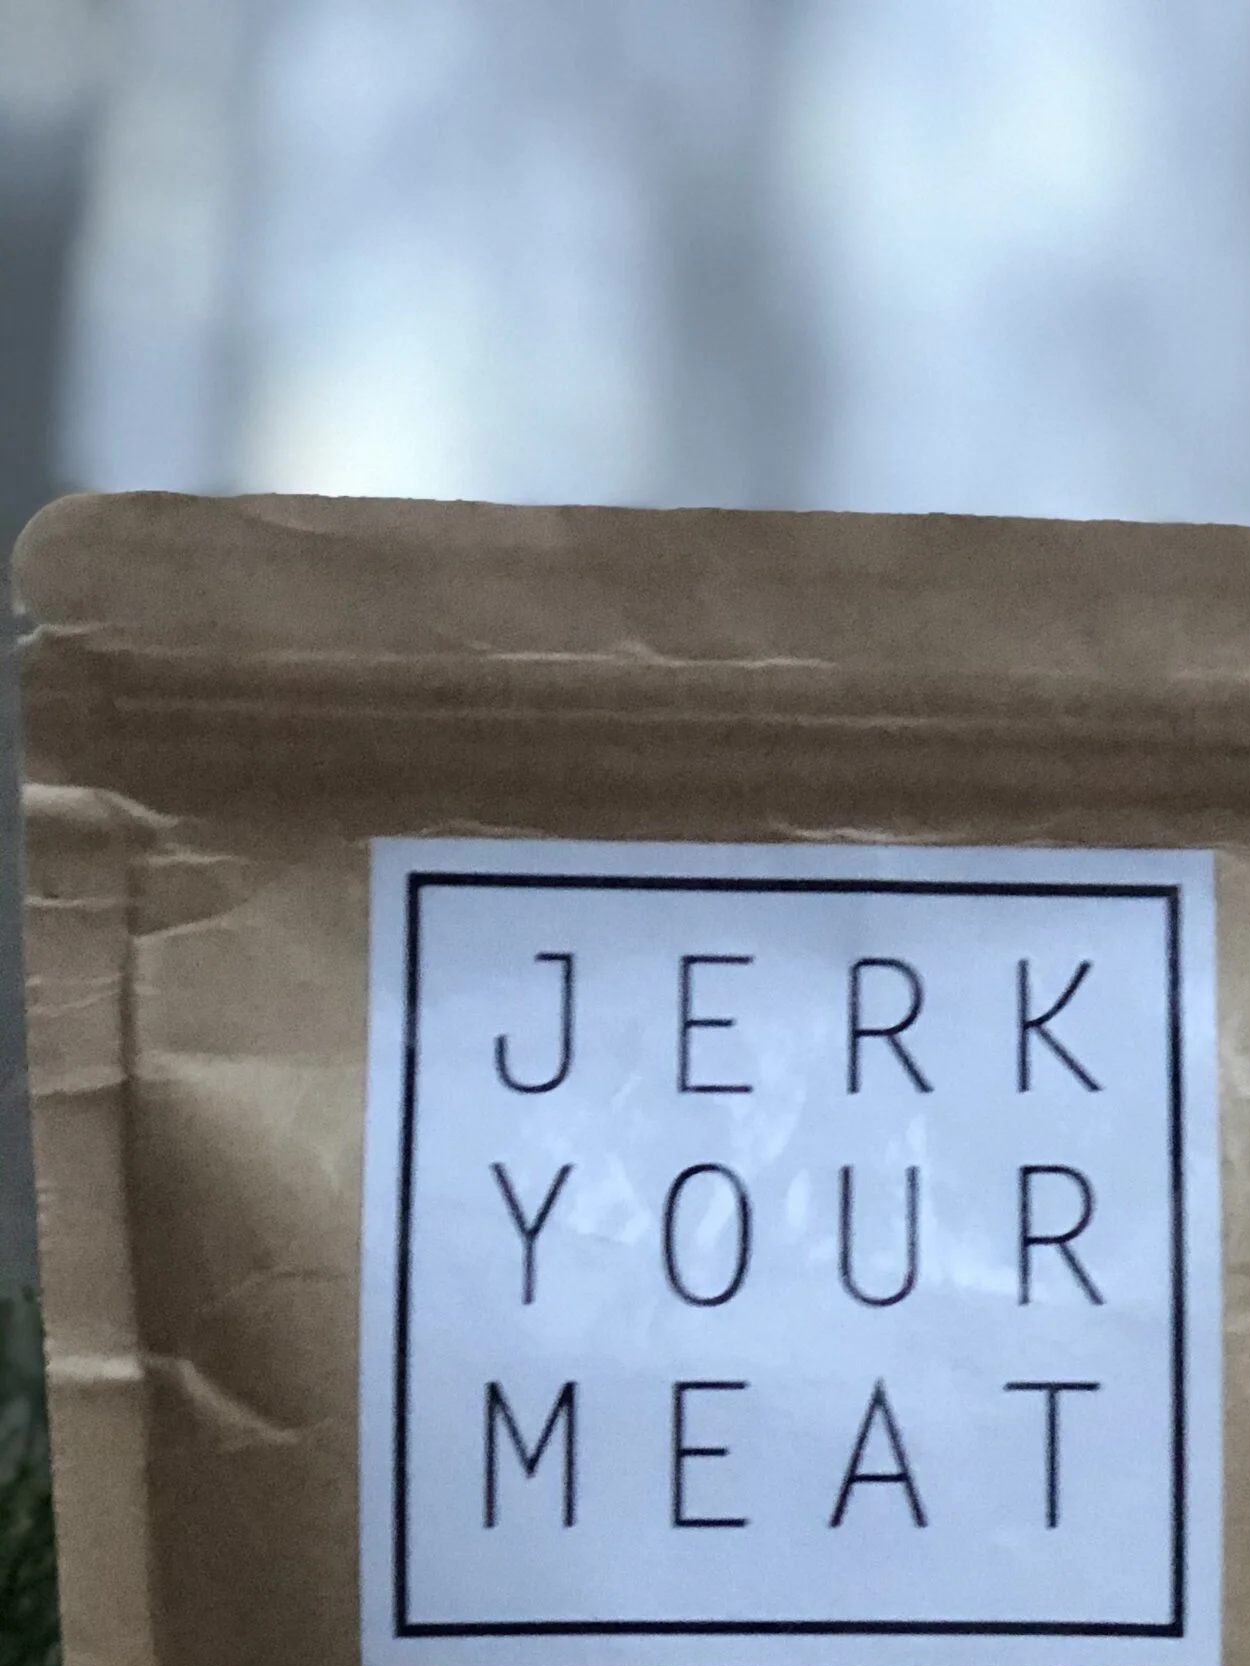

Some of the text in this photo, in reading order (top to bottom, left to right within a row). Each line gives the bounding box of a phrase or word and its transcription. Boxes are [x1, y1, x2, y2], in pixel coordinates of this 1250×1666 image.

[494, 951, 1103, 1095] JERK
[490, 1162, 1105, 1307] YOUR
[483, 1379, 1101, 1530] MEAT
